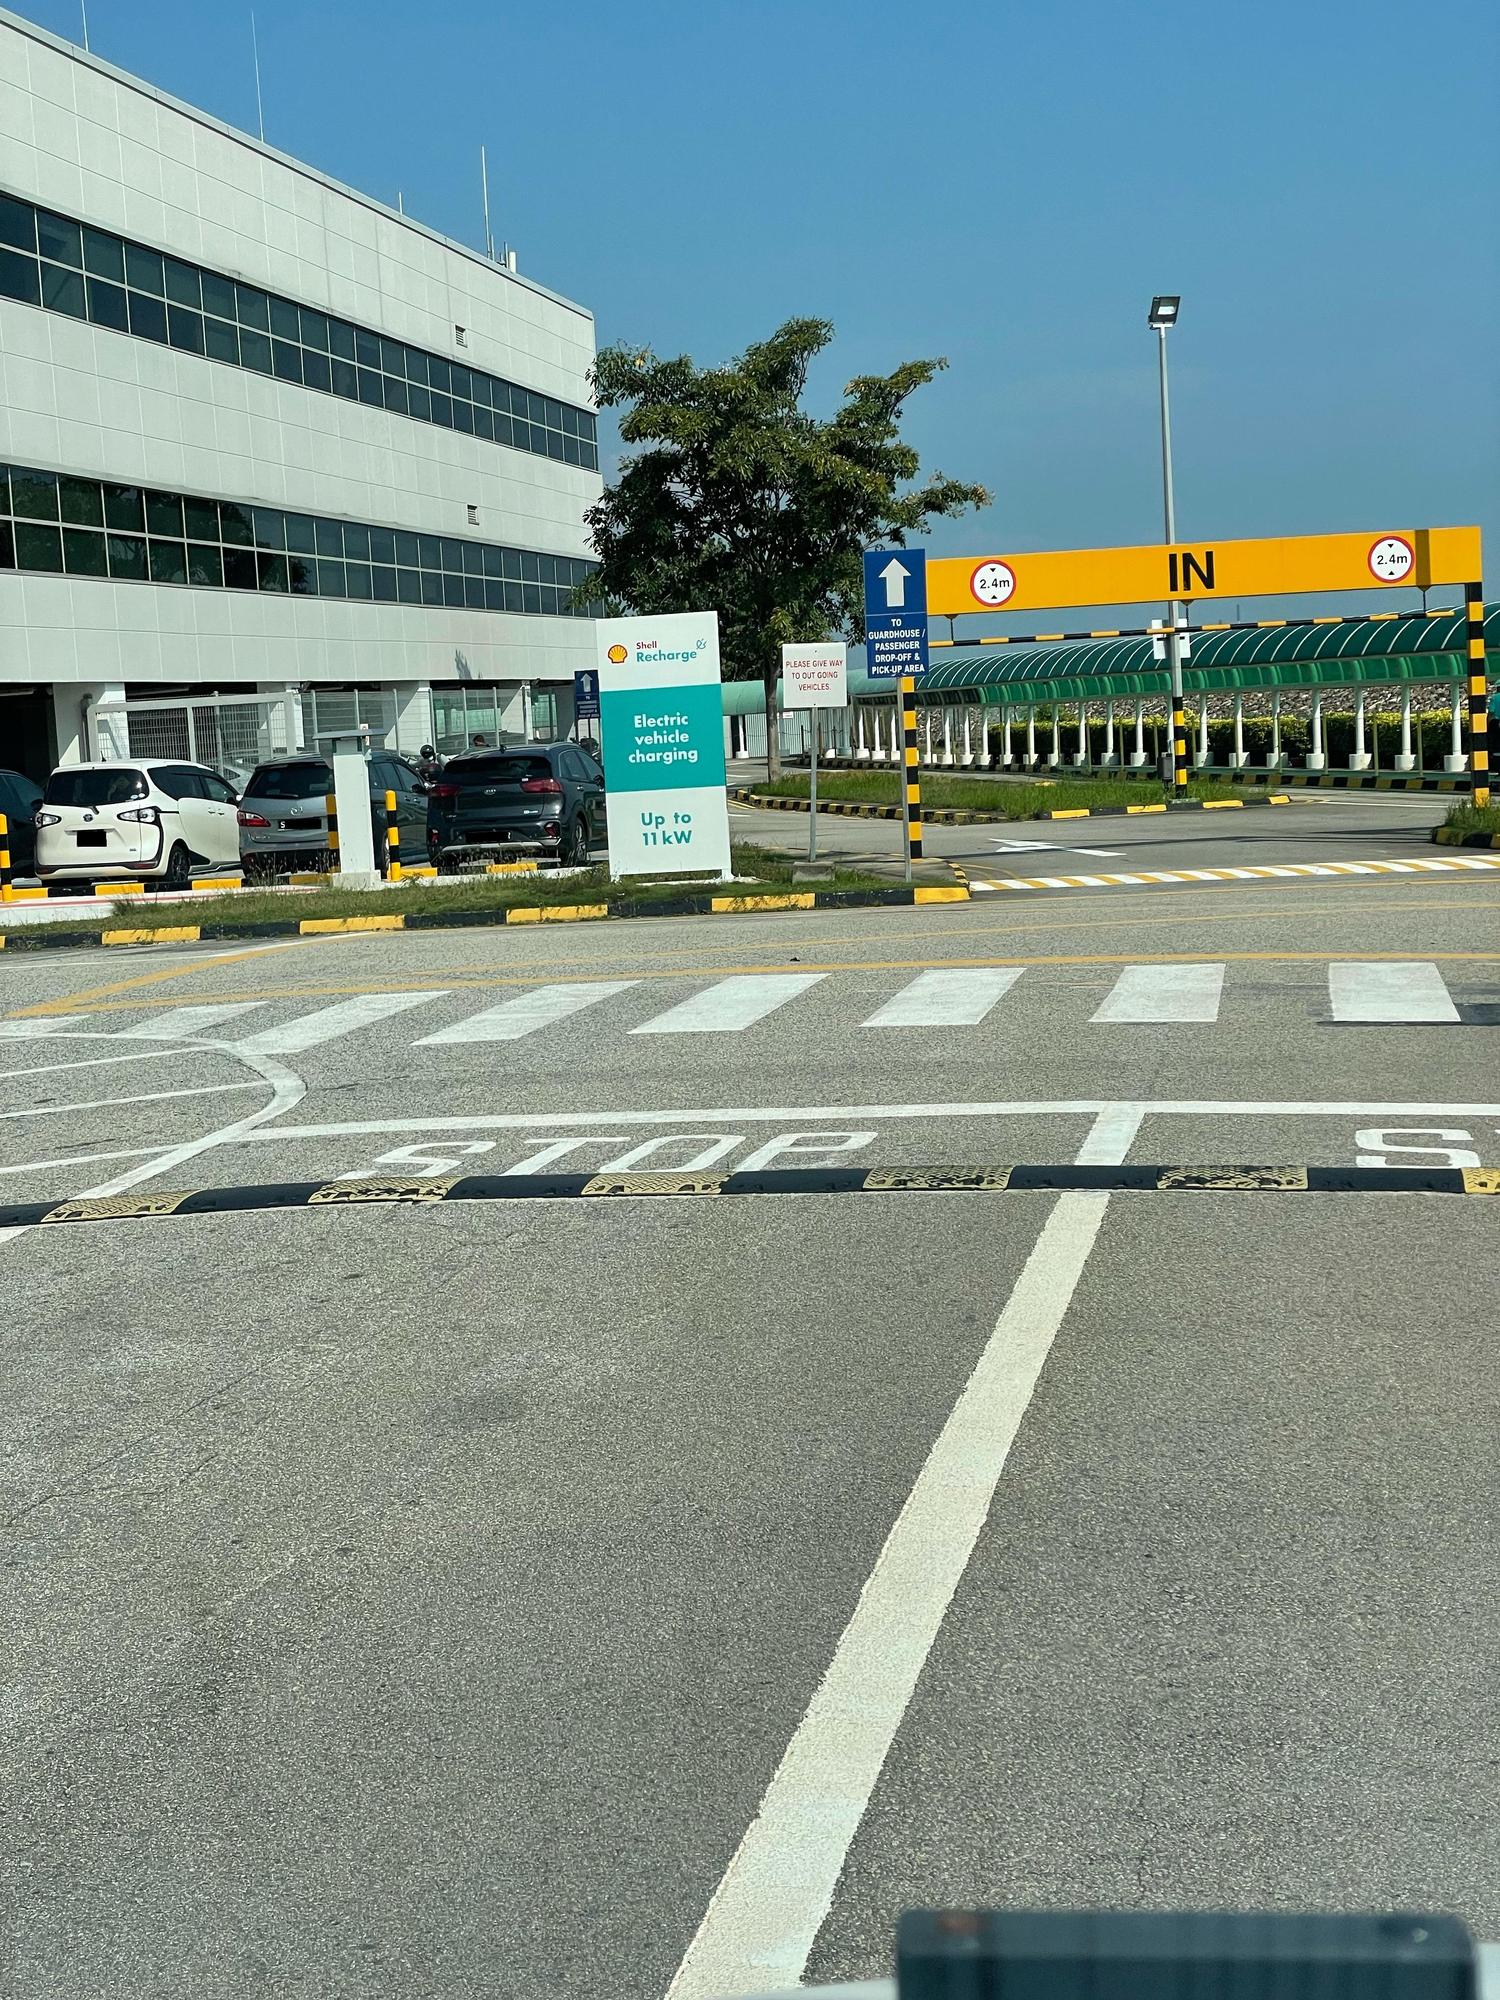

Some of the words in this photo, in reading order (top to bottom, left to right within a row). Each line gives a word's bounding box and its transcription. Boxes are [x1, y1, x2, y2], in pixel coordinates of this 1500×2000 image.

[1376, 554, 1408, 565] 2.4m
[1168, 550, 1215, 592] IN
[979, 578, 1010, 589] 2.4m
[891, 618, 902, 627] TO
[868, 629, 920, 640] GUARDHOUSE
[636, 641, 657, 650] Shell
[875, 640, 920, 651] PASSENGER
[636, 650, 697, 662] Recharge
[875, 653, 912, 663] DROP-OFF
[914, 652, 920, 661] &
[785, 660, 811, 668] PLEASE
[812, 659, 828, 668] GIVE
[829, 659, 843, 667] WAY
[871, 665, 903, 675] PICK-UP
[904, 663, 925, 673] AREA
[792, 672, 800, 680] TO
[802, 672, 815, 680] OUT
[817, 671, 838, 679] GOING
[634, 711, 689, 728] Electric
[634, 729, 689, 745] vehicle
[628, 747, 698, 764] charging
[641, 812, 666, 829] Up
[673, 812, 692, 824] to
[1355, 1128, 1500, 1168] S
[333, 1131, 878, 1180] STOP
